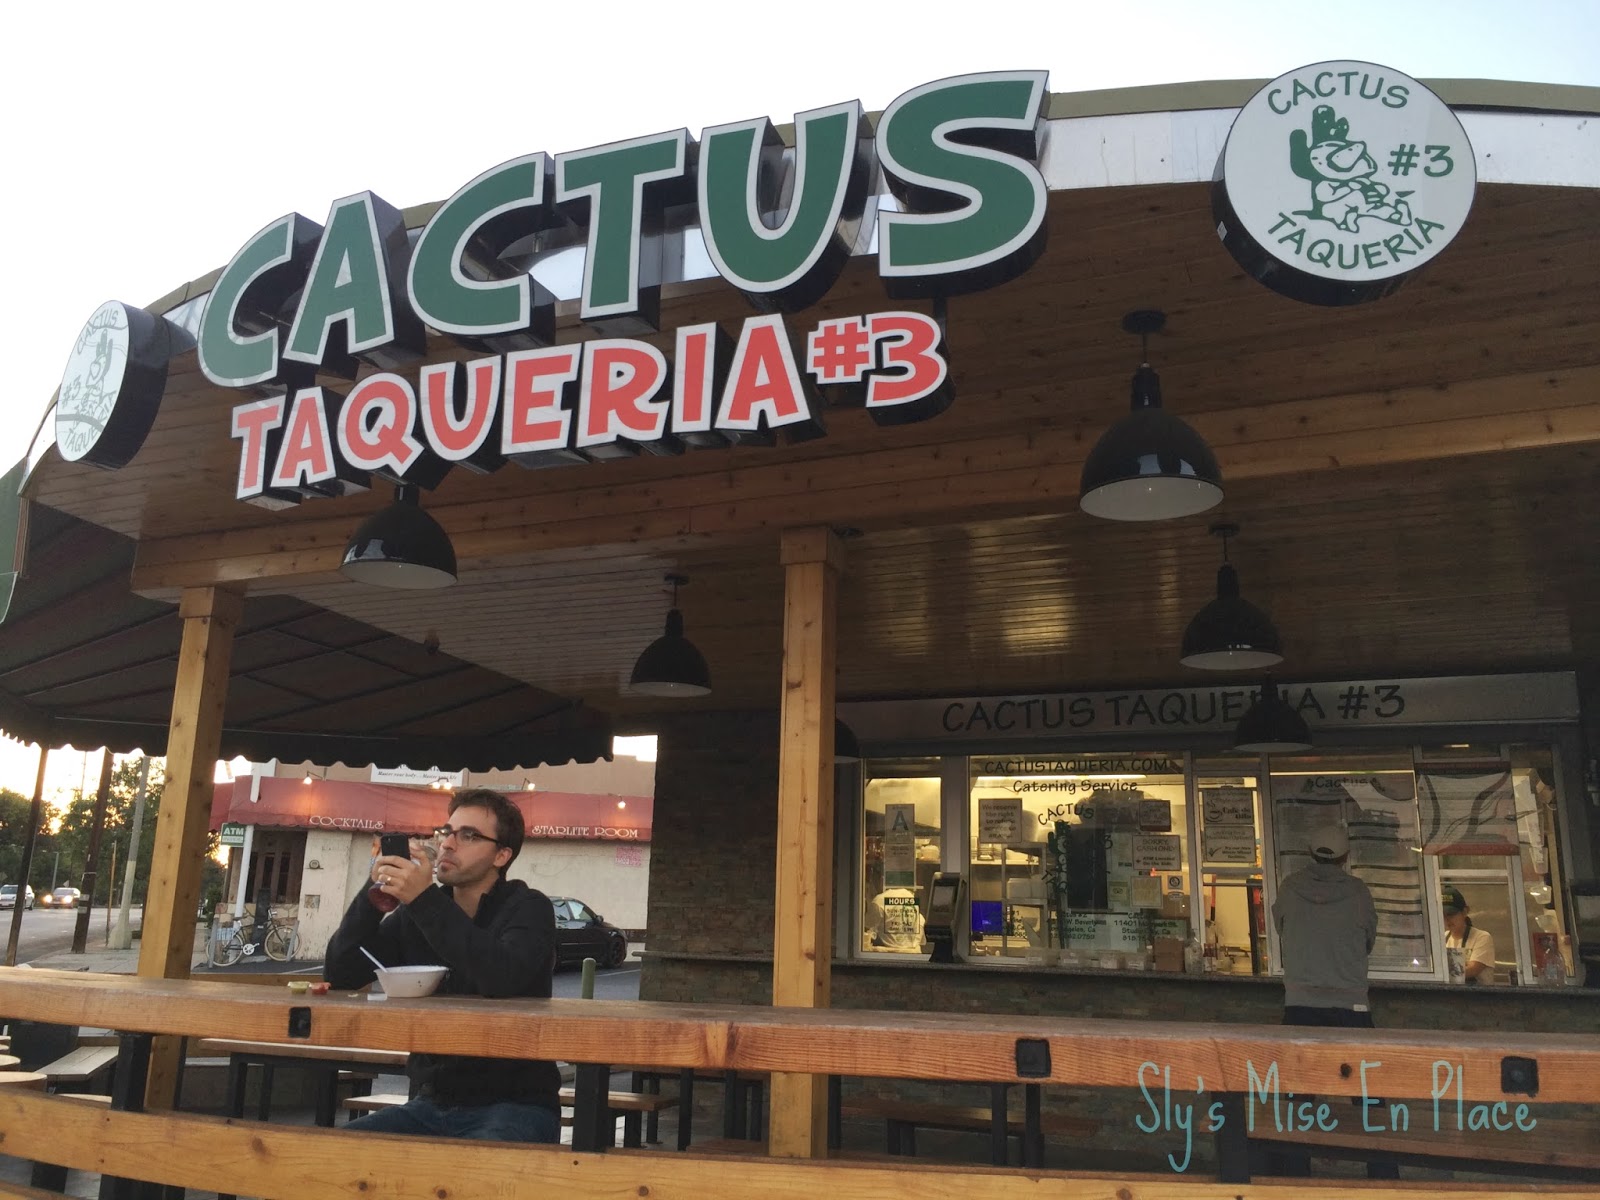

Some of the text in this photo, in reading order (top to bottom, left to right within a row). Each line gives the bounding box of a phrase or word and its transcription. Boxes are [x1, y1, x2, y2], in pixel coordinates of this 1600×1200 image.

[1267, 71, 1410, 115] CACTUS
[1387, 143, 1454, 178] #3
[197, 70, 1049, 388] CACTUS
[1267, 212, 1445, 270] TAQUERIA
[77, 309, 118, 355] CACTUS
[61, 375, 81, 409] #3
[231, 311, 948, 500] TAQUERIA #3
[942, 697, 1095, 733] CACTUS
[1337, 684, 1405, 720] #3
[985, 758, 1168, 775] CACTUSTAQUERIA.COM
[1012, 779, 1138, 795] Catering Service
[309, 815, 384, 829] COCKTAILS
[891, 811, 910, 831] A
[1037, 802, 1095, 826] CACTUS
[223, 827, 244, 836] ATM
[531, 825, 638, 838] STARLITE ROOM
[1113, 919, 1137, 927] 11401
